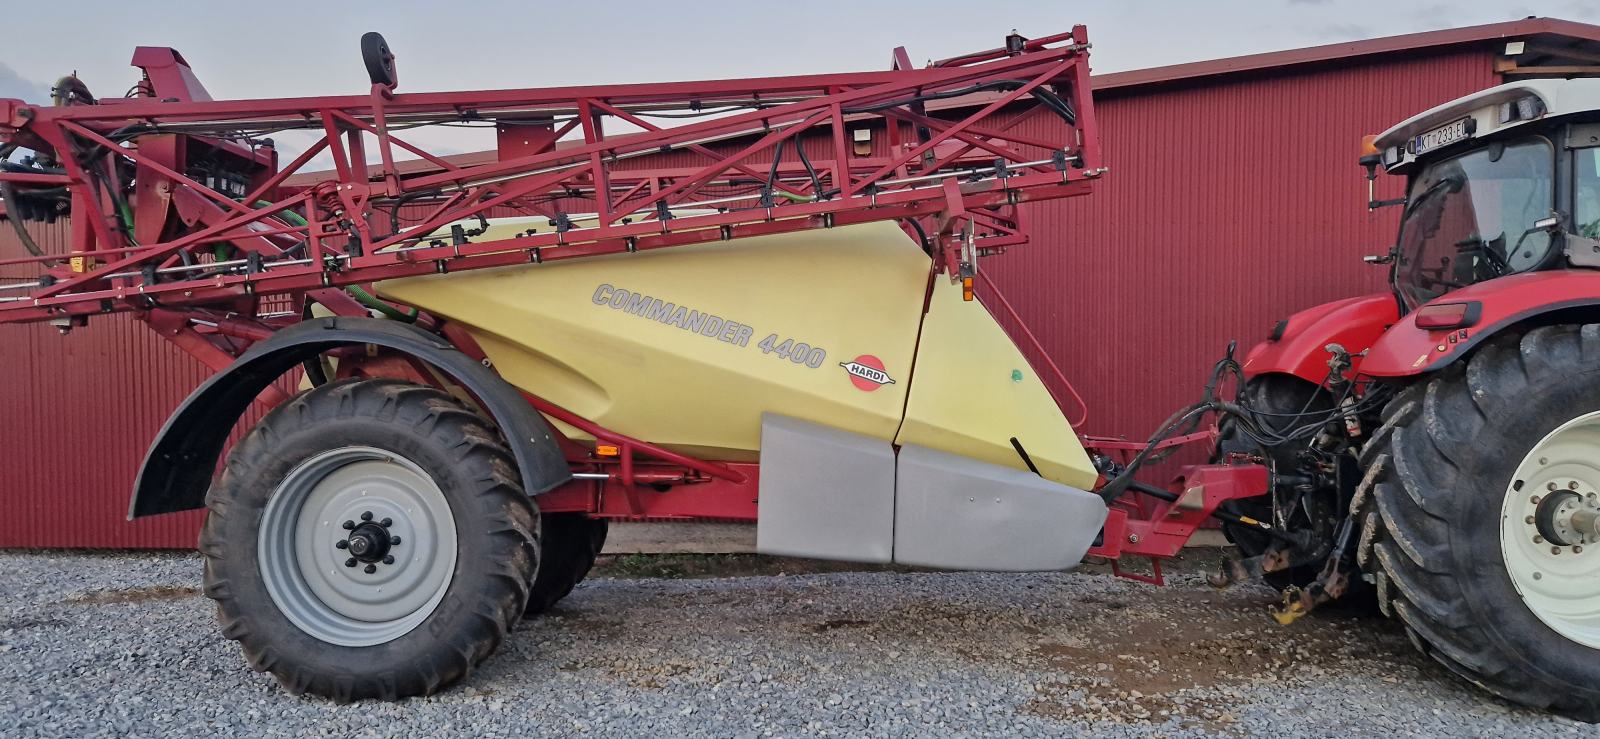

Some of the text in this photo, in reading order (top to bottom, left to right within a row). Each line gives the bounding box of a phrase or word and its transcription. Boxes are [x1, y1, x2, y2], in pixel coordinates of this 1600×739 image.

[1421, 134, 1431, 150] KT
[591, 283, 827, 369] COMMANDER 4400
[851, 364, 884, 381] HARDI
